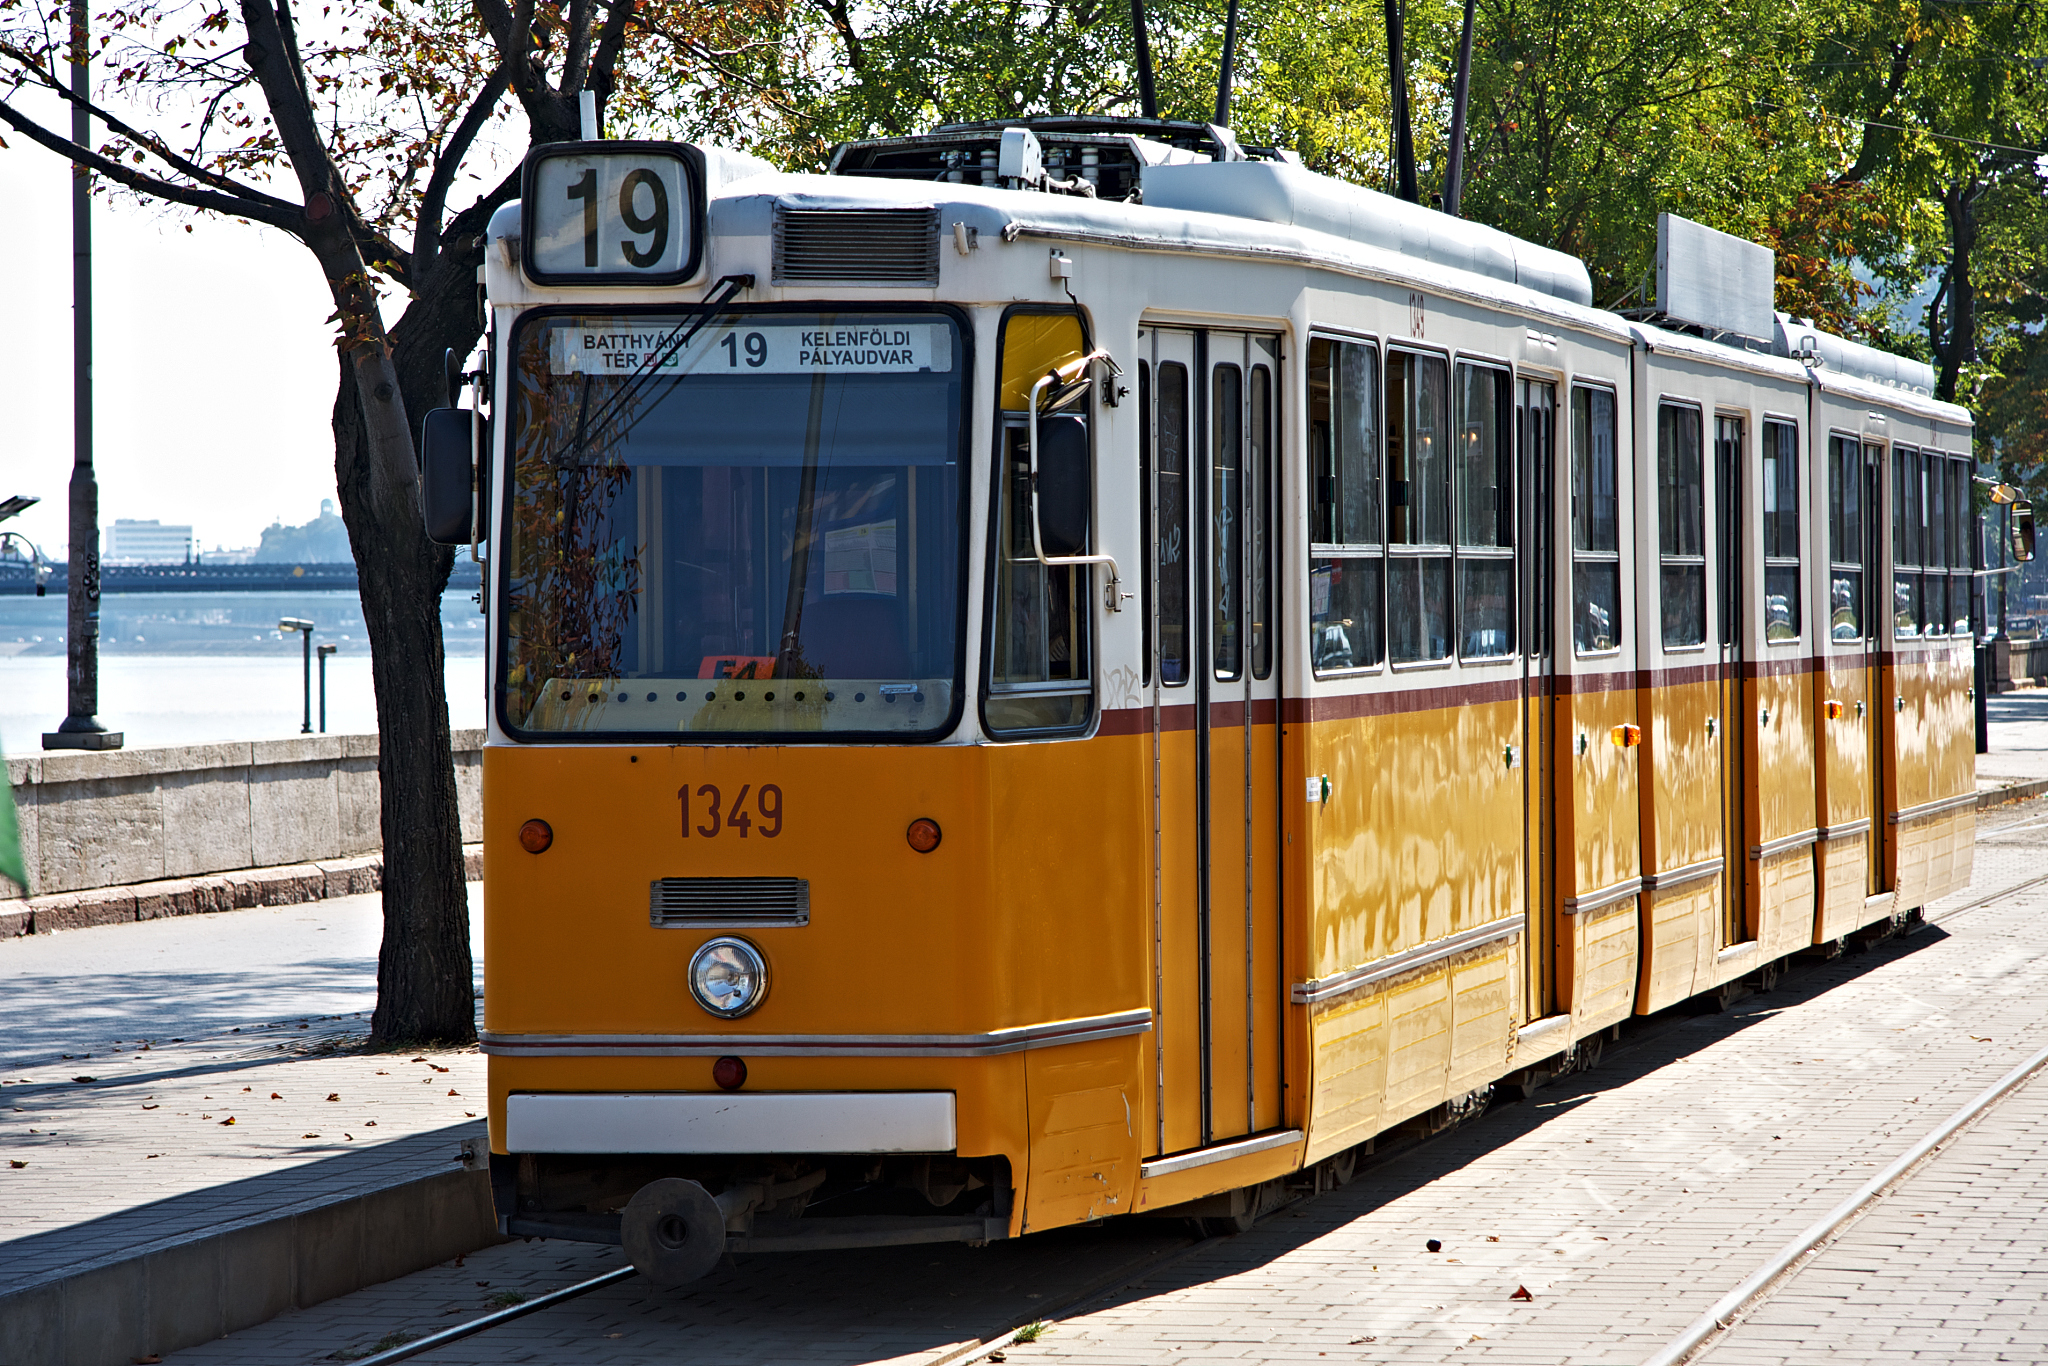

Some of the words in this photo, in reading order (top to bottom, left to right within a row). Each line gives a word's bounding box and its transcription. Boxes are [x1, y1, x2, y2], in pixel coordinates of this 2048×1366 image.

[567, 168, 669, 268] 19
[583, 331, 692, 349] BATTHYÁNY
[801, 328, 910, 347] KELENFÖLDI
[602, 350, 638, 368] TÉR
[721, 331, 768, 368] 19
[799, 347, 914, 366] PÁLYAUDVAR
[678, 784, 782, 838] 1349
